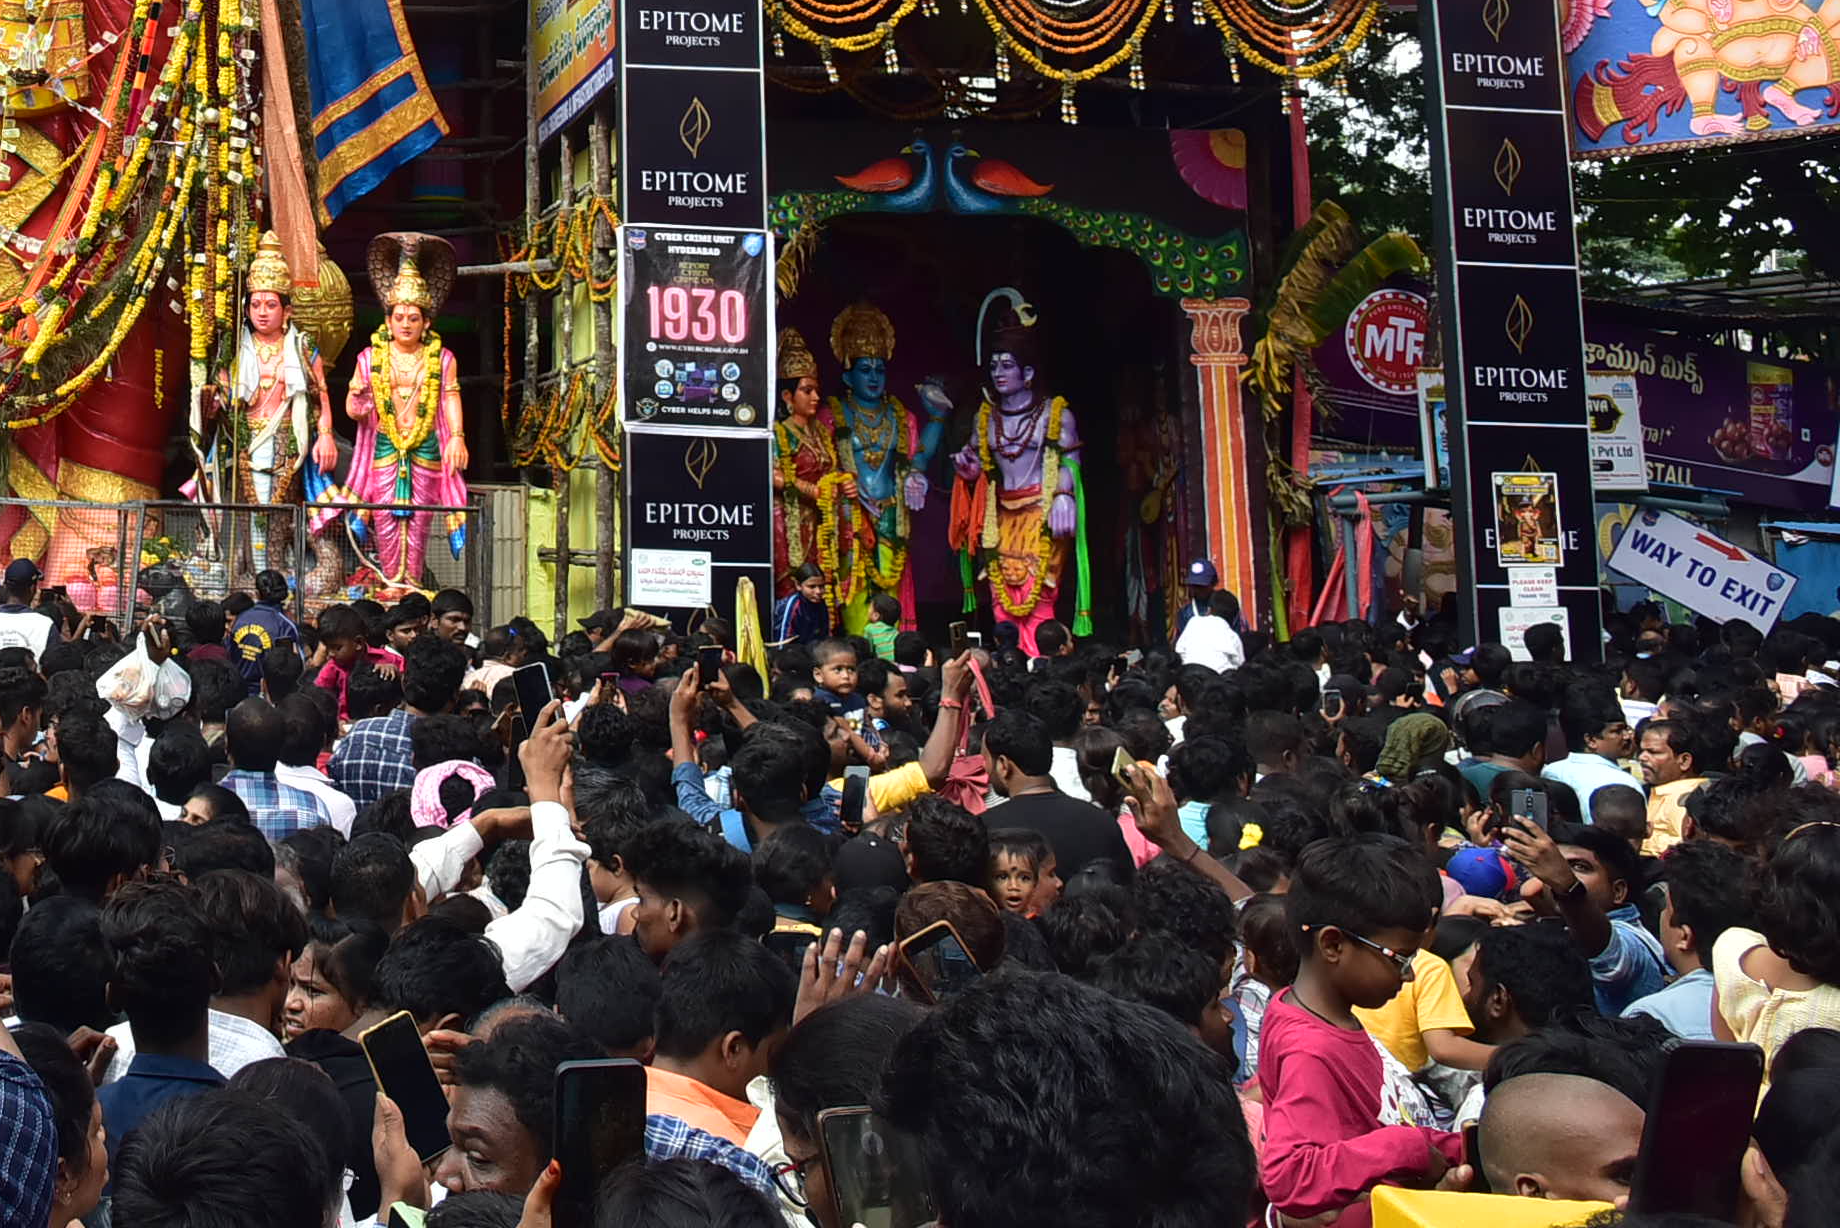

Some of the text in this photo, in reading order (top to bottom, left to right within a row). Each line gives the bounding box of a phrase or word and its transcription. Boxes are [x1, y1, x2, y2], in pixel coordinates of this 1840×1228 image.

[668, 245, 721, 257] HYDERABAD
[646, 285, 747, 344] 1930
[1474, 366, 1569, 389] EPITOME
[1498, 392, 1549, 403] PROJECTS
[1598, 445, 1634, 459] Pvt Ltd
[645, 502, 754, 526] EPITOME
[672, 529, 731, 542] PROJECTS
[1630, 527, 1777, 618] WAY TO EXIT
